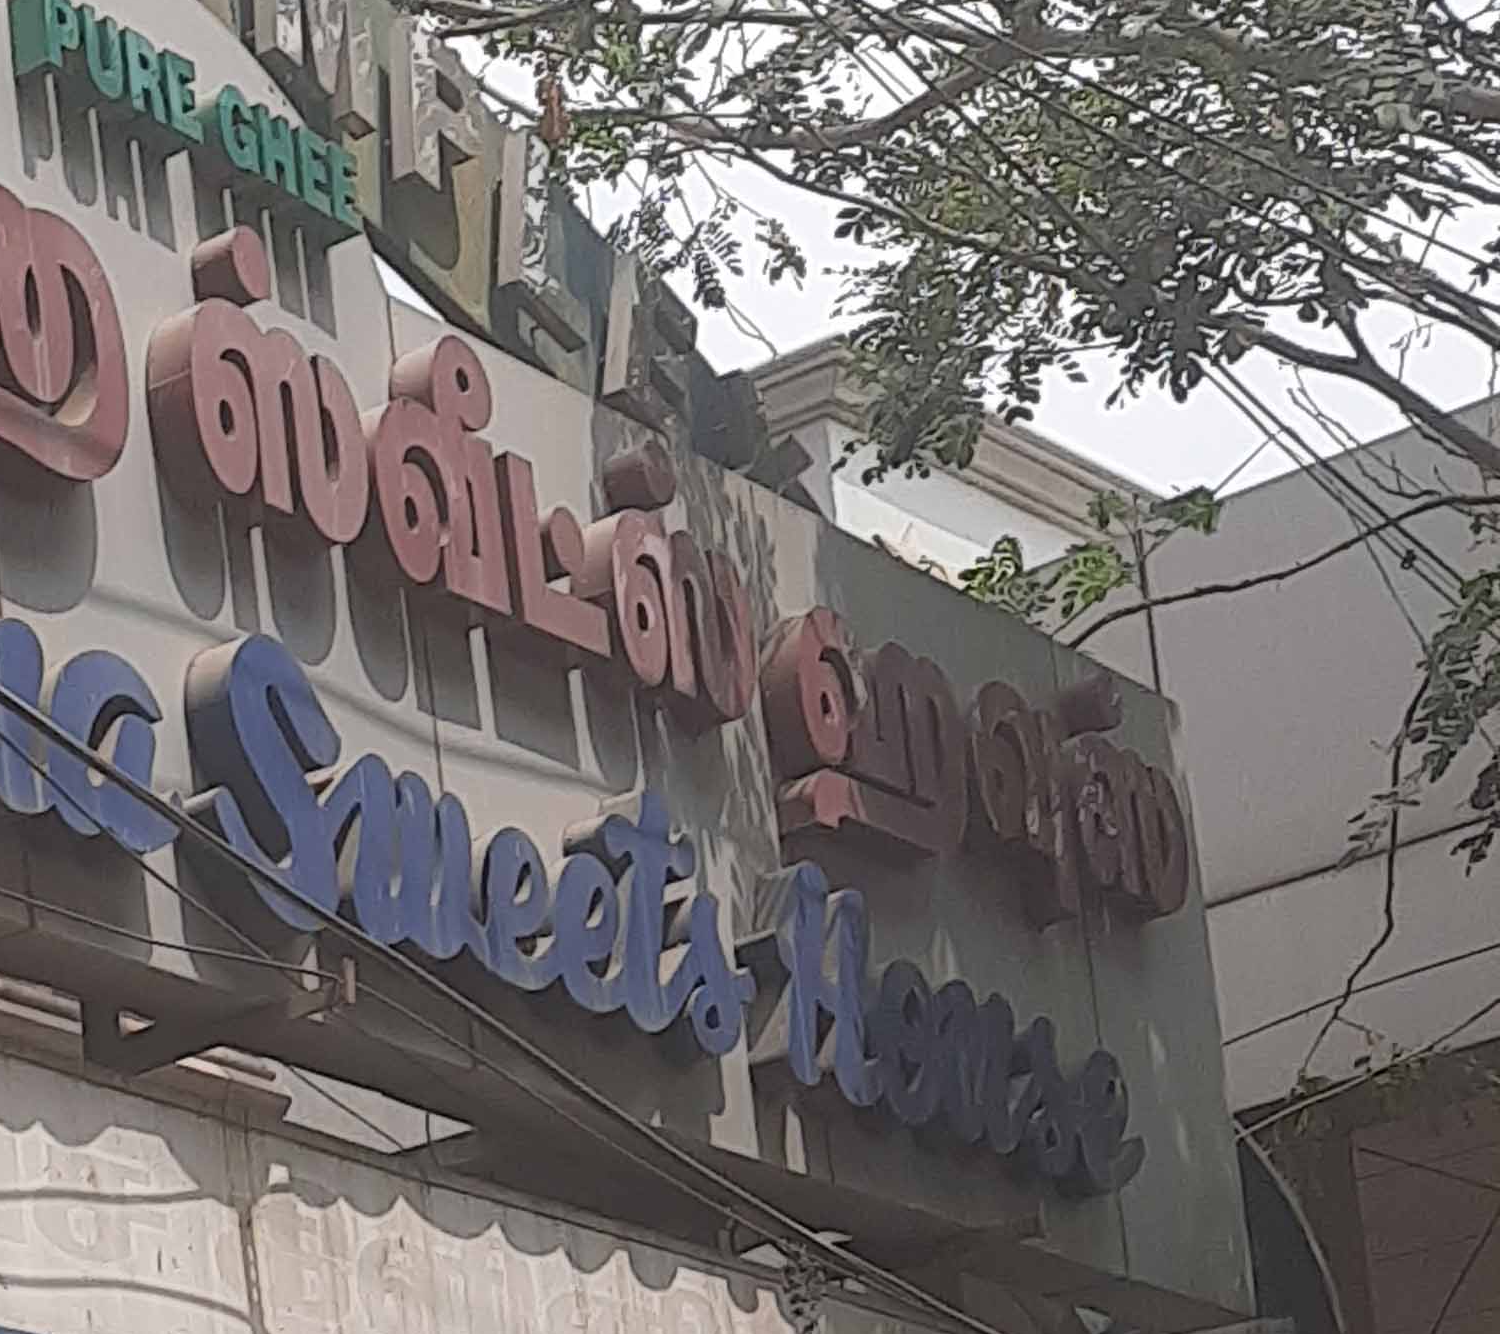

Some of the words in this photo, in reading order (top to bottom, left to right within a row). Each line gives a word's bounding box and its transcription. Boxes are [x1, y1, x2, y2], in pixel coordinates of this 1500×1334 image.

[204, 86, 367, 234] GHEE
[186, 633, 754, 1055] Sweets
[738, 861, 1147, 1199] House
